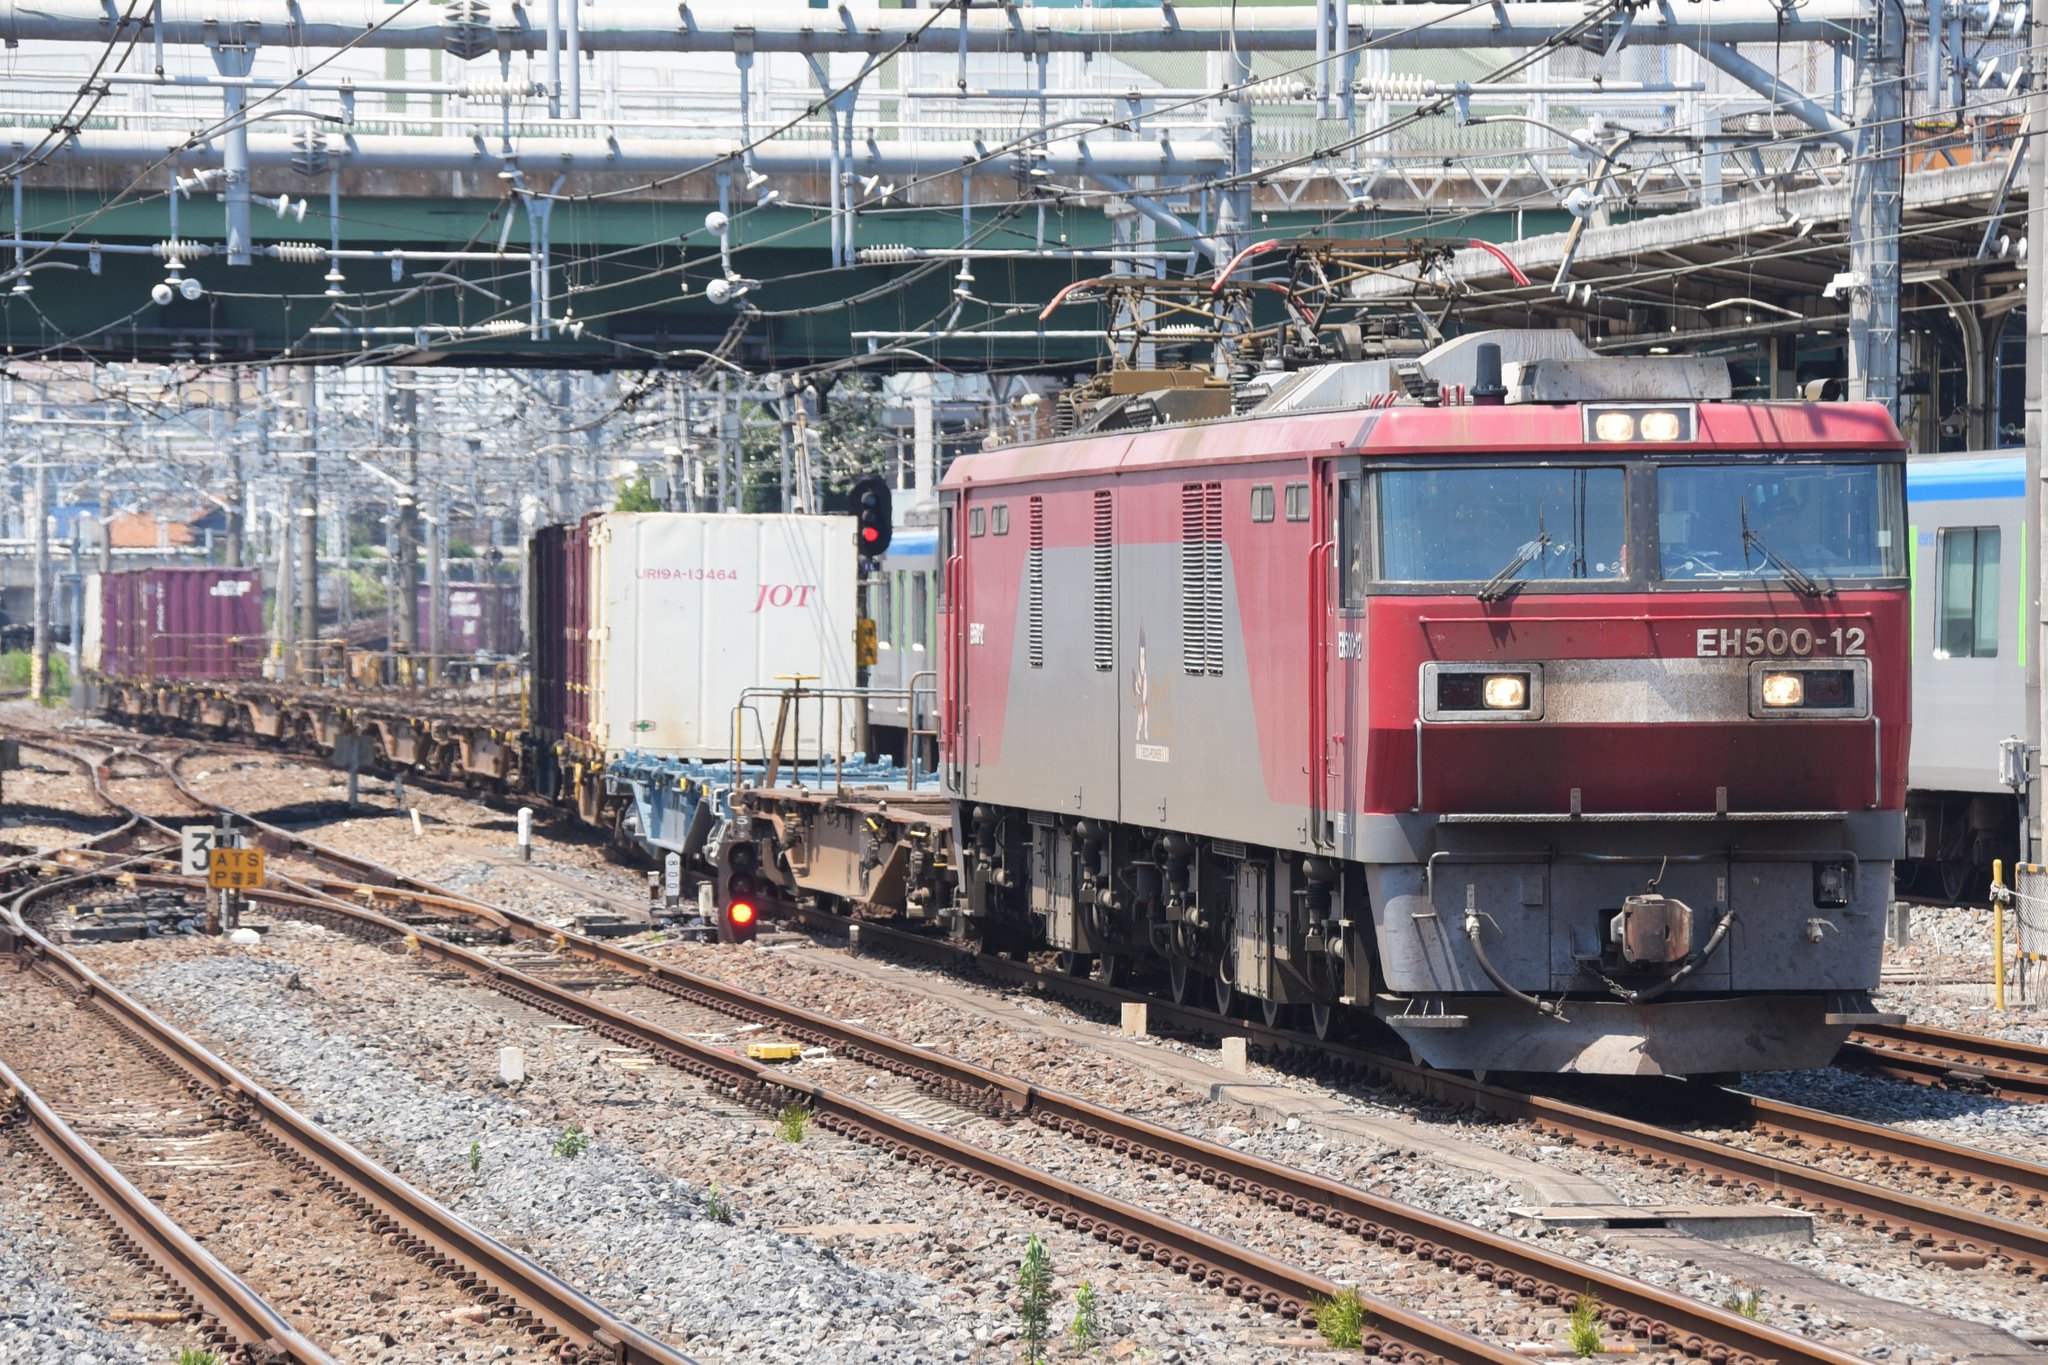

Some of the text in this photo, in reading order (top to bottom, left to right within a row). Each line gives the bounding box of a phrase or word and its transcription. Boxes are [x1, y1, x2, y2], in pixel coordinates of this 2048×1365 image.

[635, 568, 738, 580] UR19A-13464
[748, 584, 816, 613] JOT
[1696, 627, 1866, 656] EH500-12
[191, 832, 211, 871] 3
[215, 852, 259, 867] ATS
